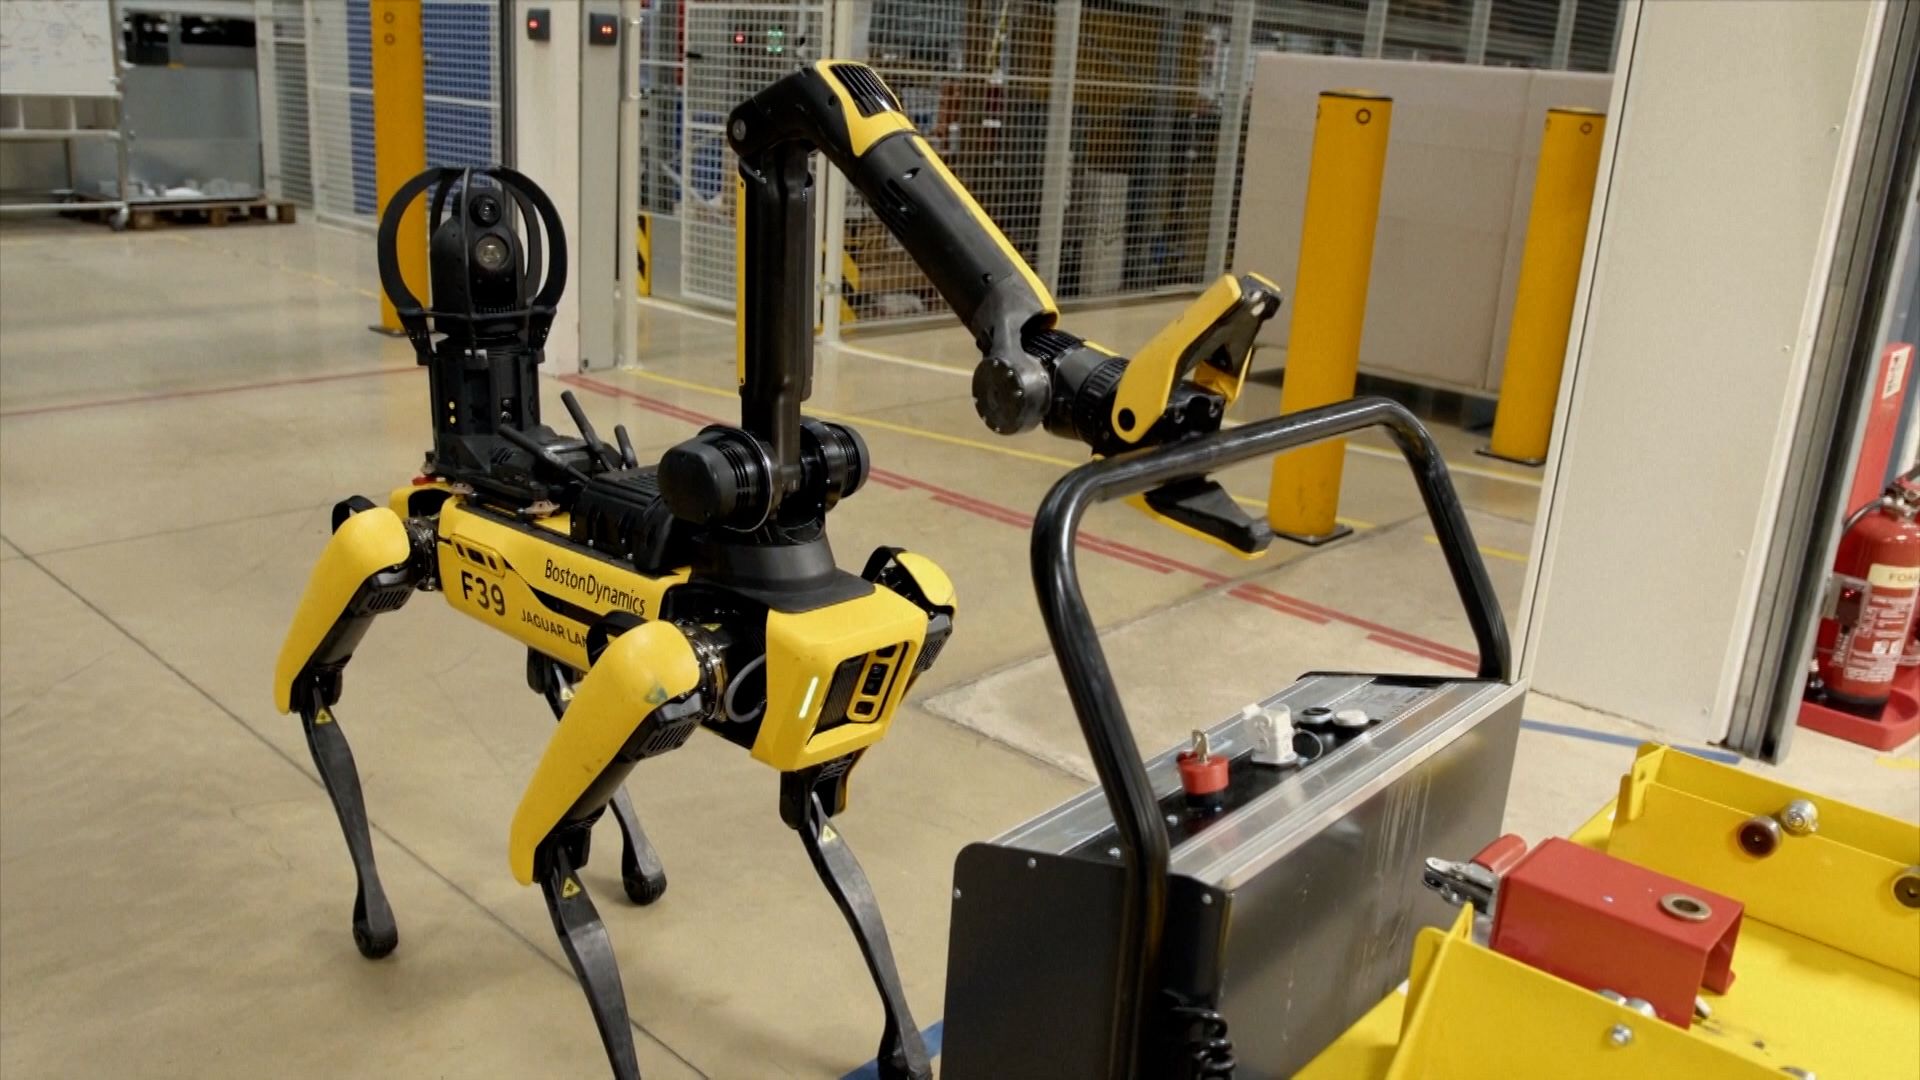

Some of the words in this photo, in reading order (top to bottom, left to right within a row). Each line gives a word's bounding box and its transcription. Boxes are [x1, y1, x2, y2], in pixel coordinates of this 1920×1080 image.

[461, 570, 506, 616] F39
[544, 559, 646, 616] BostonDynamics
[522, 608, 566, 640] JAGUAR
